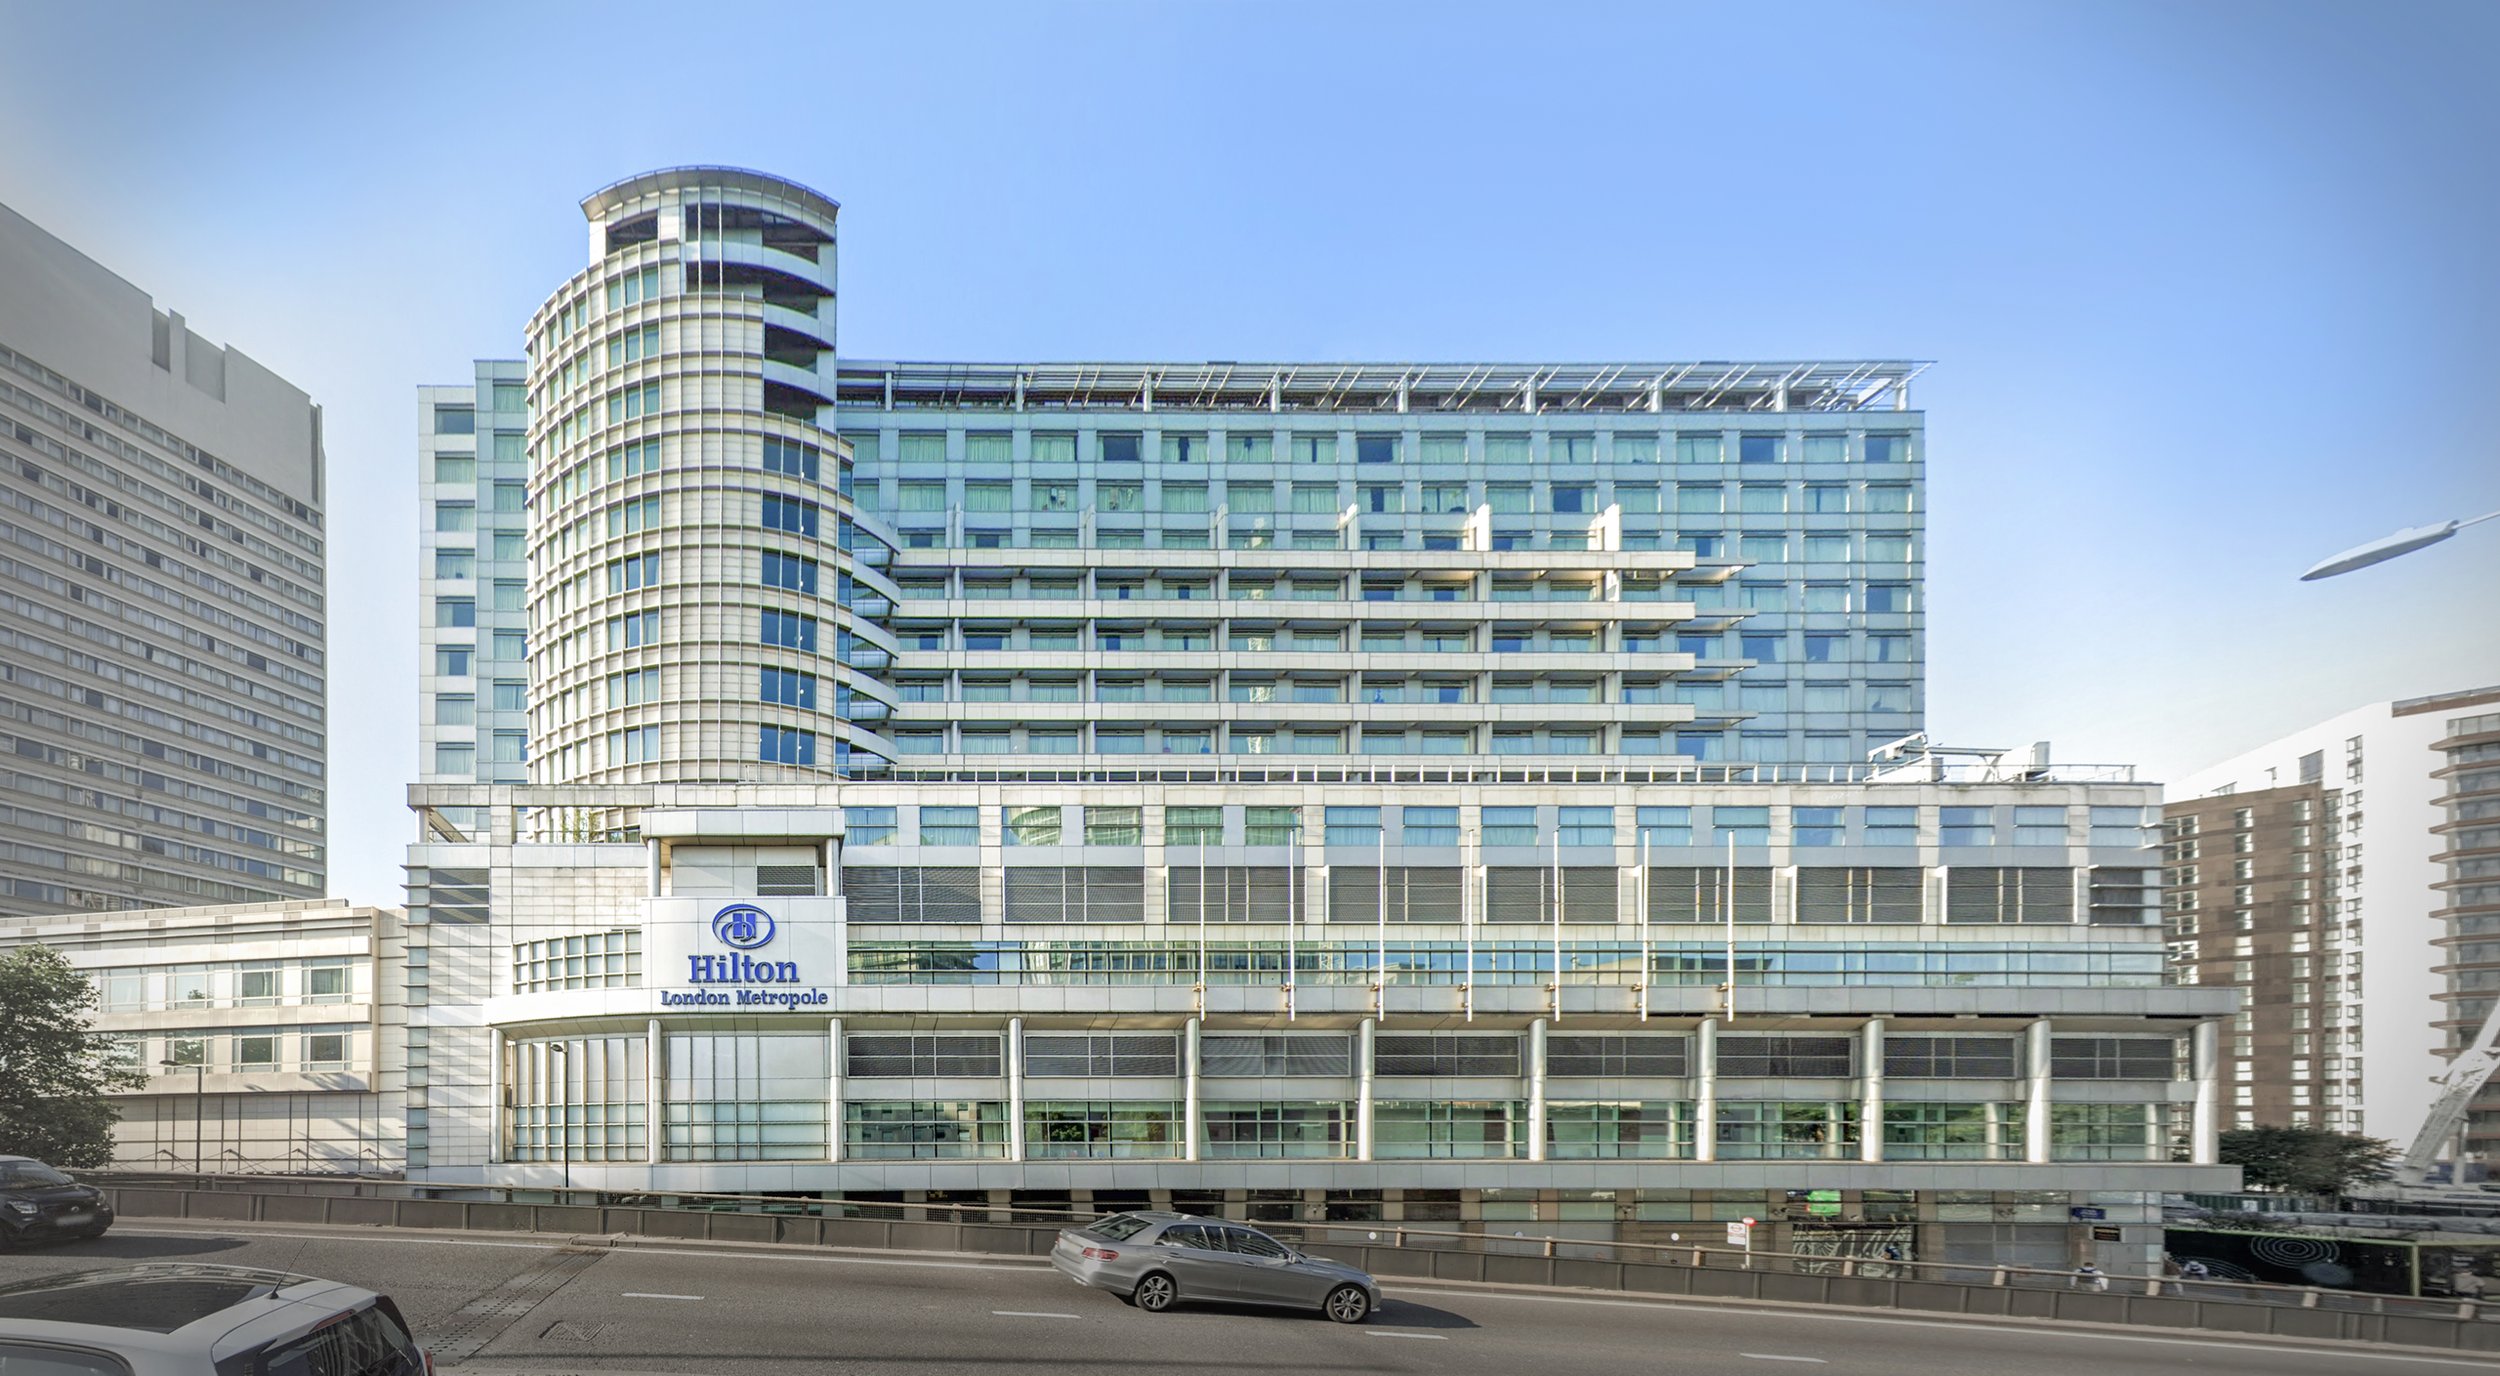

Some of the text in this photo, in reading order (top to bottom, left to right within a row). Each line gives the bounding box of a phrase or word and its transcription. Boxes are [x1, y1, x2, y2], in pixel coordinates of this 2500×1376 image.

[688, 952, 800, 983] Hilton
[661, 988, 829, 1010] London Metropole
